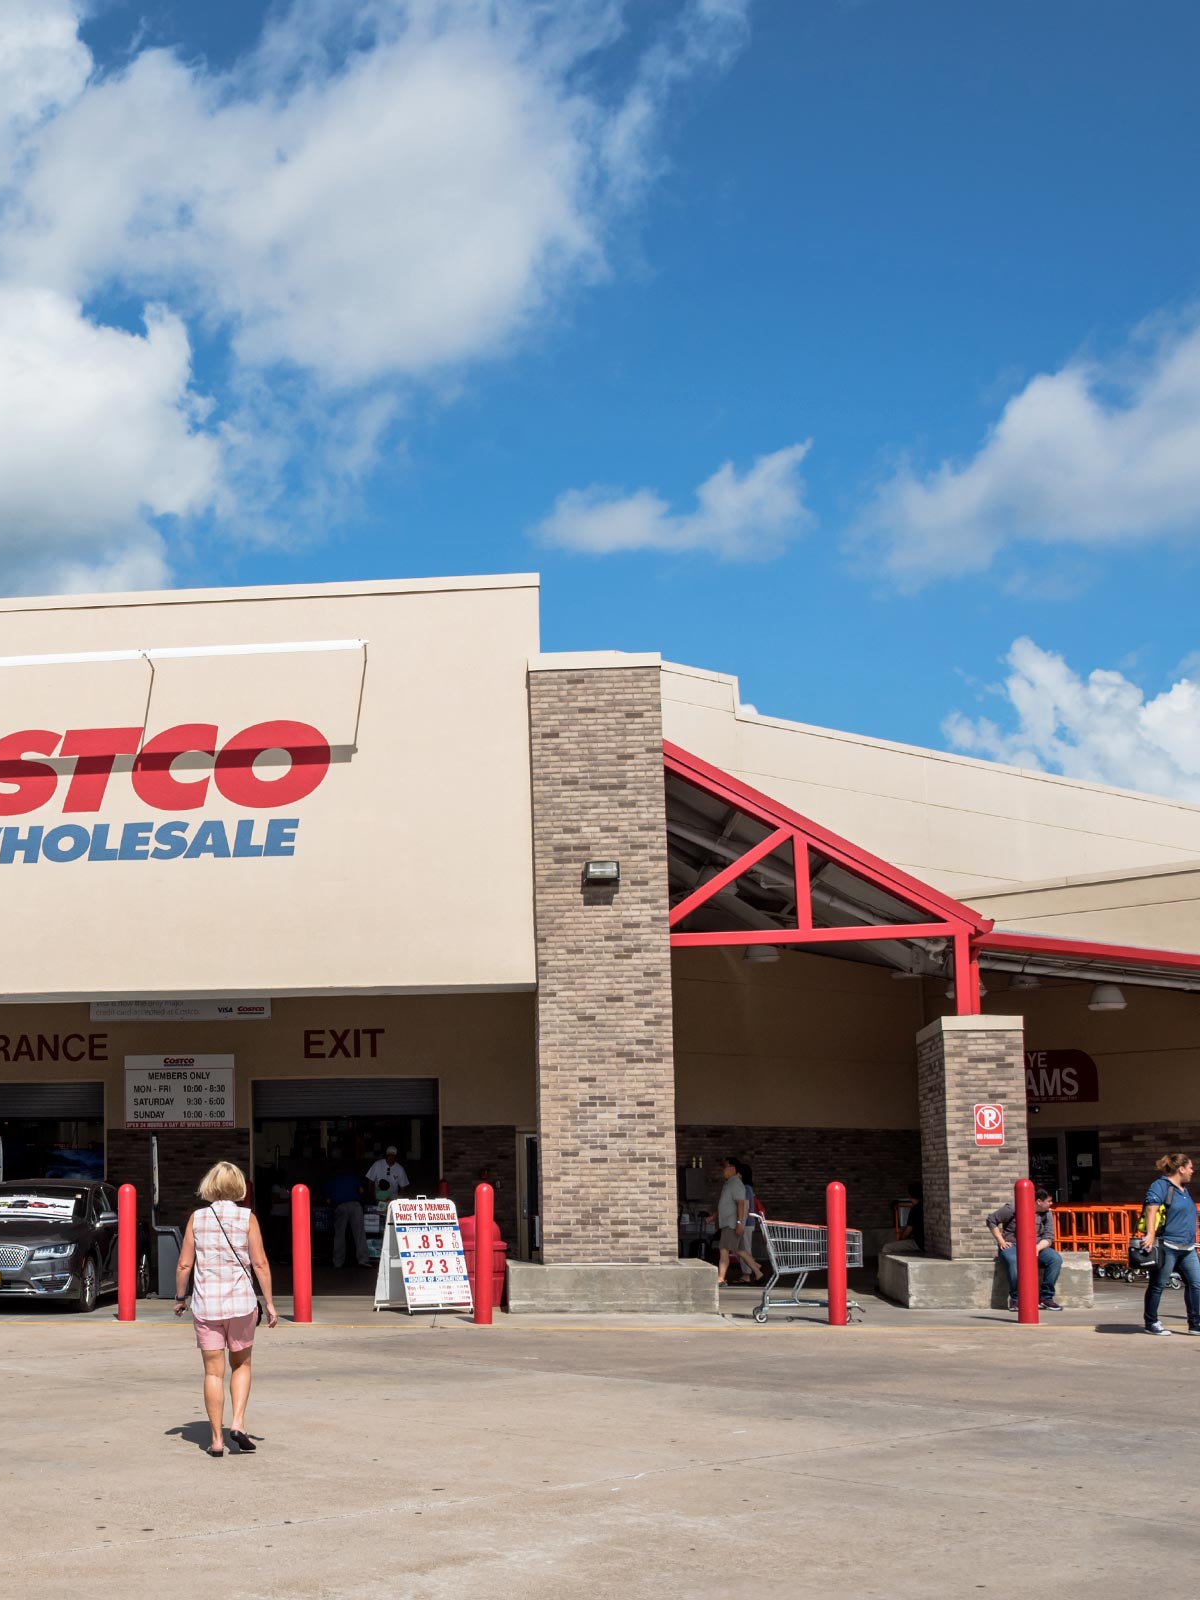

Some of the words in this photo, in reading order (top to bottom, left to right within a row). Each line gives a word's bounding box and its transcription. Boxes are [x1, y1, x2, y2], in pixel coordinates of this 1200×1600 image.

[217, 1006, 233, 1014] VISA
[303, 1028, 386, 1060] EXIT
[1027, 1052, 1047, 1068] YE
[148, 1072, 188, 1080] MEMBERS
[190, 1071, 211, 1080] ONLY
[1026, 1067, 1079, 1096] AMS
[133, 1085, 152, 1093] MON
[158, 1085, 171, 1093] FRI
[183, 1085, 203, 1093] 10:00
[133, 1098, 174, 1106] SATURDAY
[133, 1111, 165, 1119] SUNDAY
[183, 1110, 203, 1118] 10:00
[398, 1203, 423, 1212] TODAY'S
[424, 1203, 451, 1211] MEMBER
[395, 1213, 414, 1221] PRICE
[414, 1213, 427, 1221] FOR
[427, 1212, 457, 1221] GASOLINE
